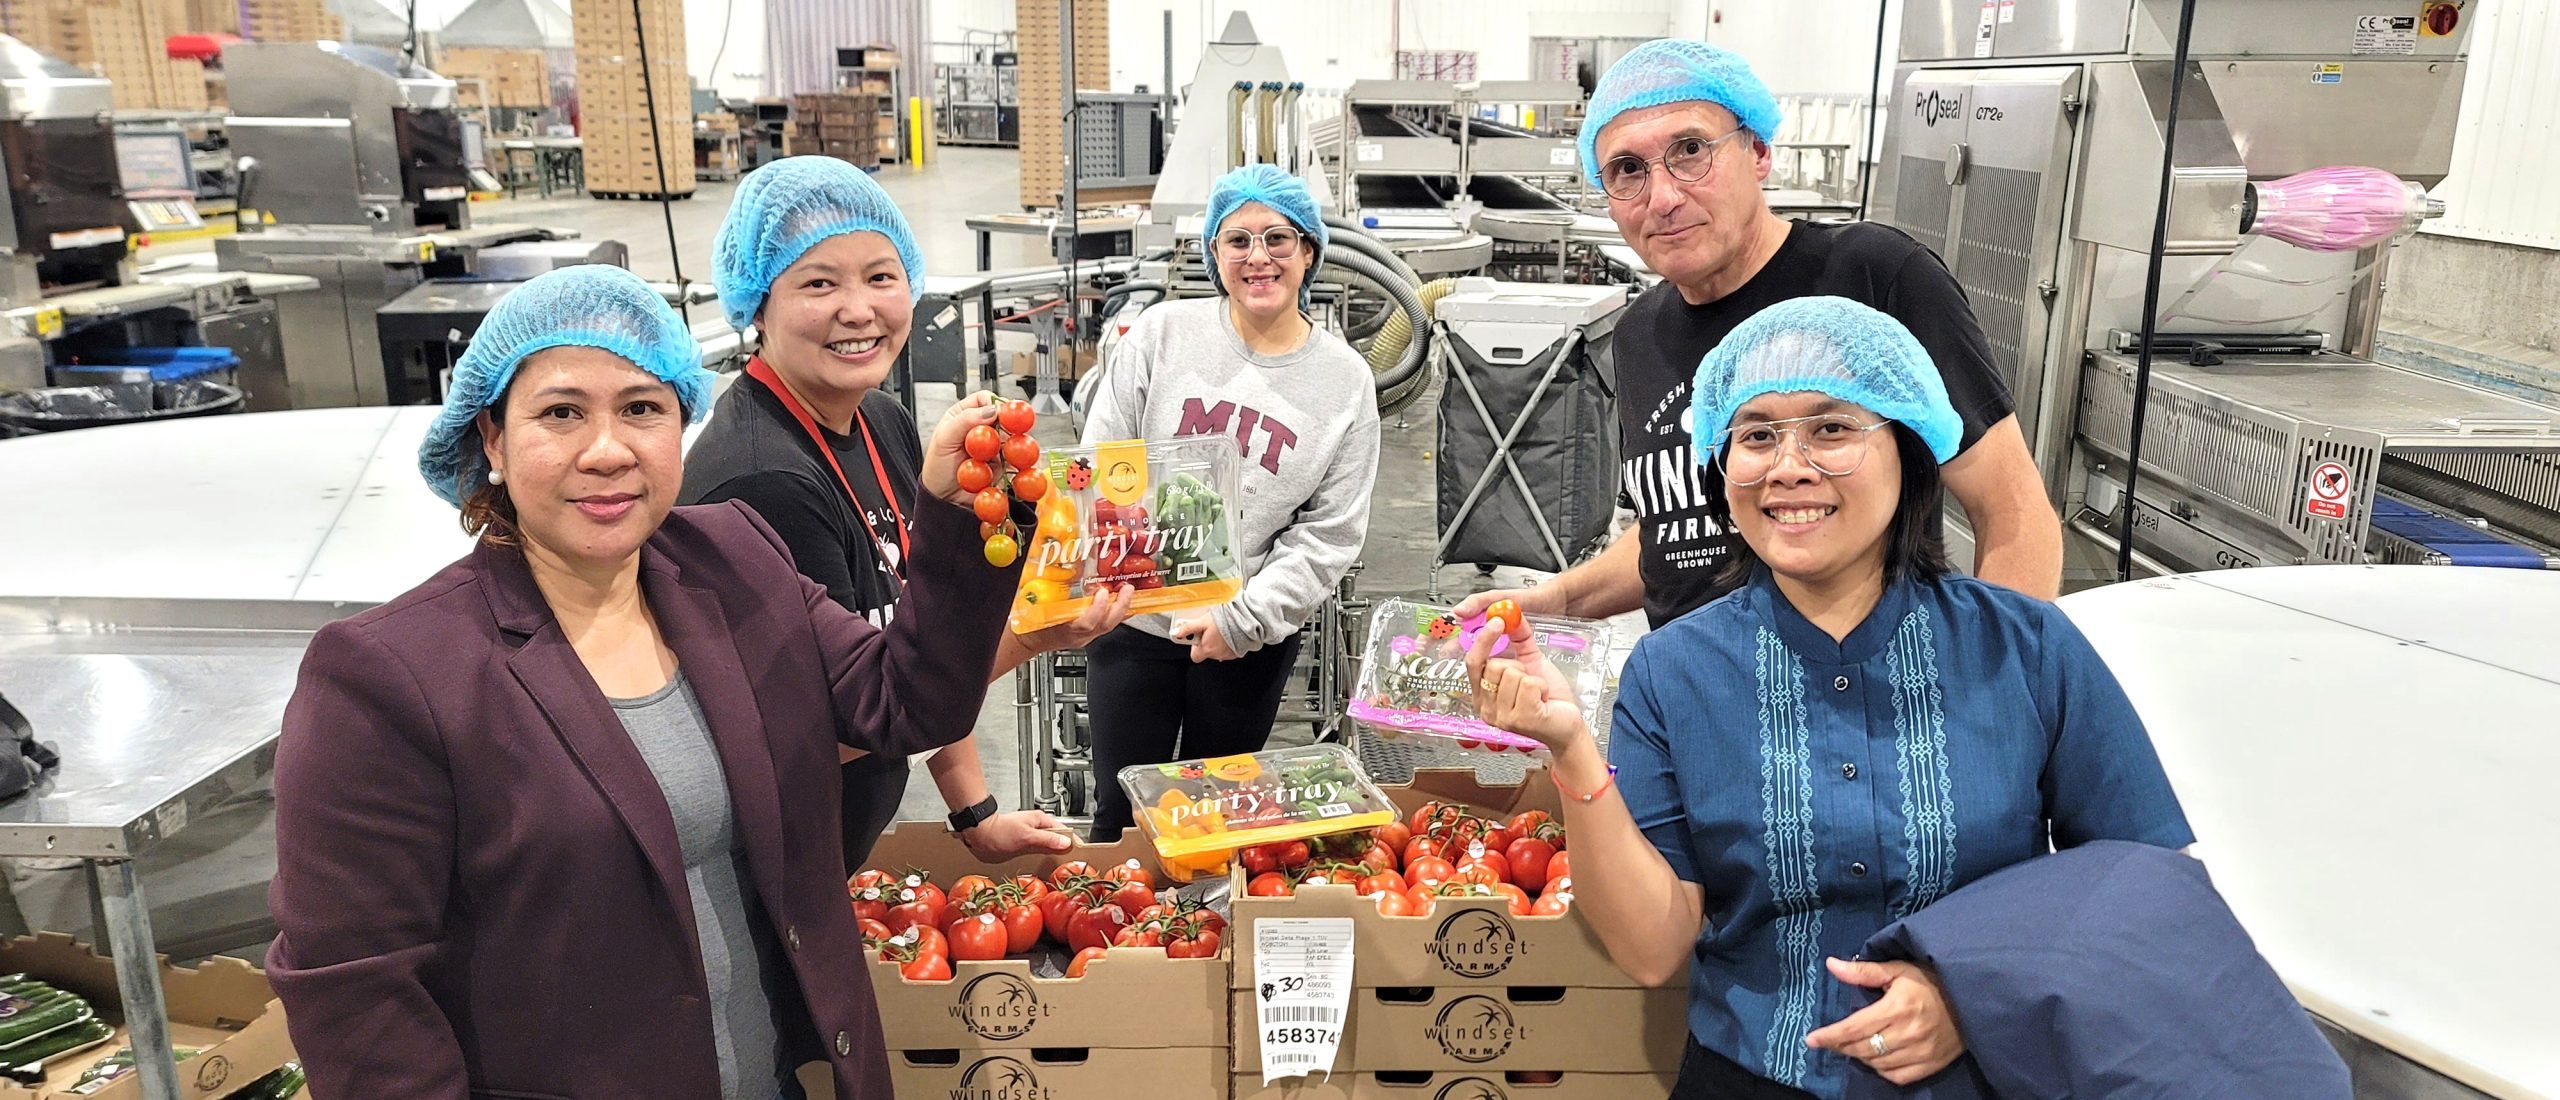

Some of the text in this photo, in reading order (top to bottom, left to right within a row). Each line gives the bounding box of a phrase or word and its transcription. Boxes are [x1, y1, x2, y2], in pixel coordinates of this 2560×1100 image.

[1644, 381, 1686, 433] FRESH
[1173, 398, 1298, 476] MIT
[1659, 423, 1675, 436] EST
[866, 510, 878, 527] &
[1037, 522, 1214, 577] party tray
[1665, 546, 1727, 561] GREENHOUSE
[1677, 557, 1713, 570] GROWN
[1169, 790, 1266, 826] party
[1272, 780, 1343, 804] tray
[1424, 937, 1528, 955] windset
[1443, 962, 1508, 971] FARMS
[1278, 976, 1304, 993] 30
[948, 1001, 1050, 1018] windset
[967, 1025, 1031, 1033] FARMS
[1424, 1024, 1526, 1040] windset
[1443, 1047, 1506, 1056] FARMS
[949, 1086, 1050, 1100] windset
